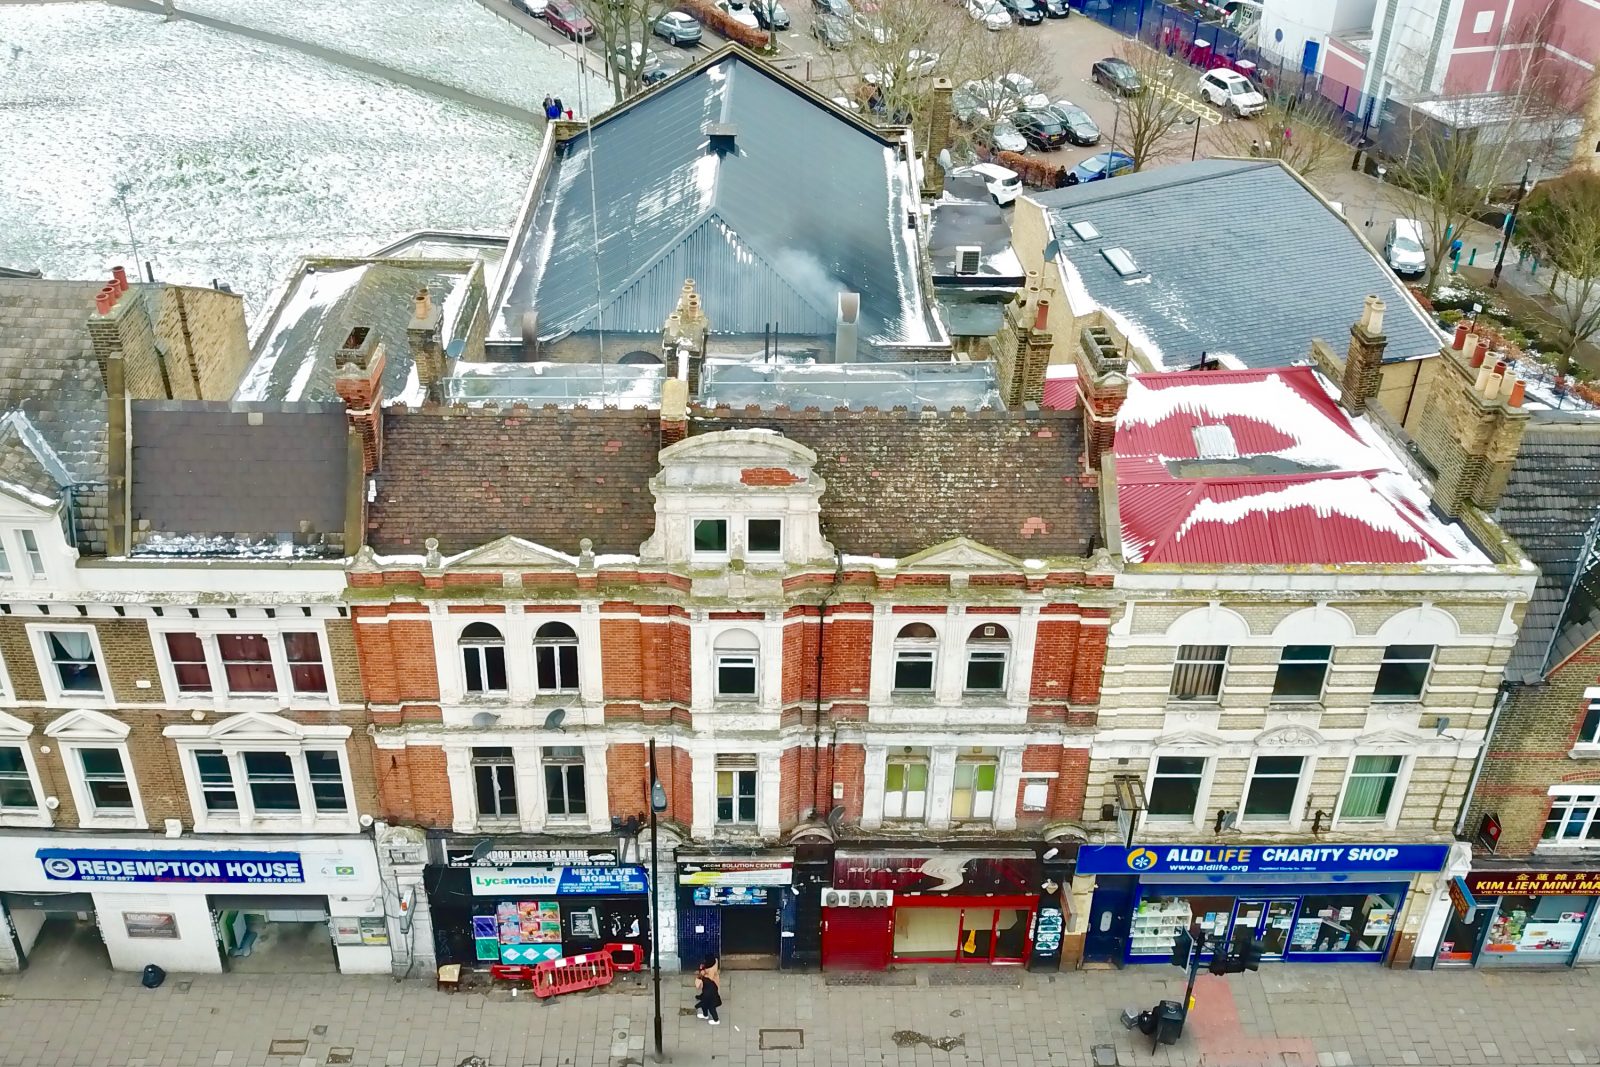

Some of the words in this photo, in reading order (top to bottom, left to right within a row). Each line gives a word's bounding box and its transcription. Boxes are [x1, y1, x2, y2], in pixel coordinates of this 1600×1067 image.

[511, 850, 548, 859] EXPRESS
[549, 850, 568, 859] CAR
[568, 850, 589, 859] HIRE
[1166, 848, 1252, 862] ALDLIFE
[1262, 848, 1344, 862] CHARITY
[1347, 848, 1399, 861] SHOP
[77, 860, 220, 877] REDEMPTION
[226, 862, 301, 877] HOUSE
[571, 868, 601, 876] NEXT
[1169, 864, 1249, 872] www.aldlife.org
[475, 876, 556, 886] Lycamobile
[581, 875, 630, 883] MOBILES
[1476, 881, 1505, 890] KIM
[1507, 881, 1540, 890] LIEN
[1541, 881, 1577, 890] MINI
